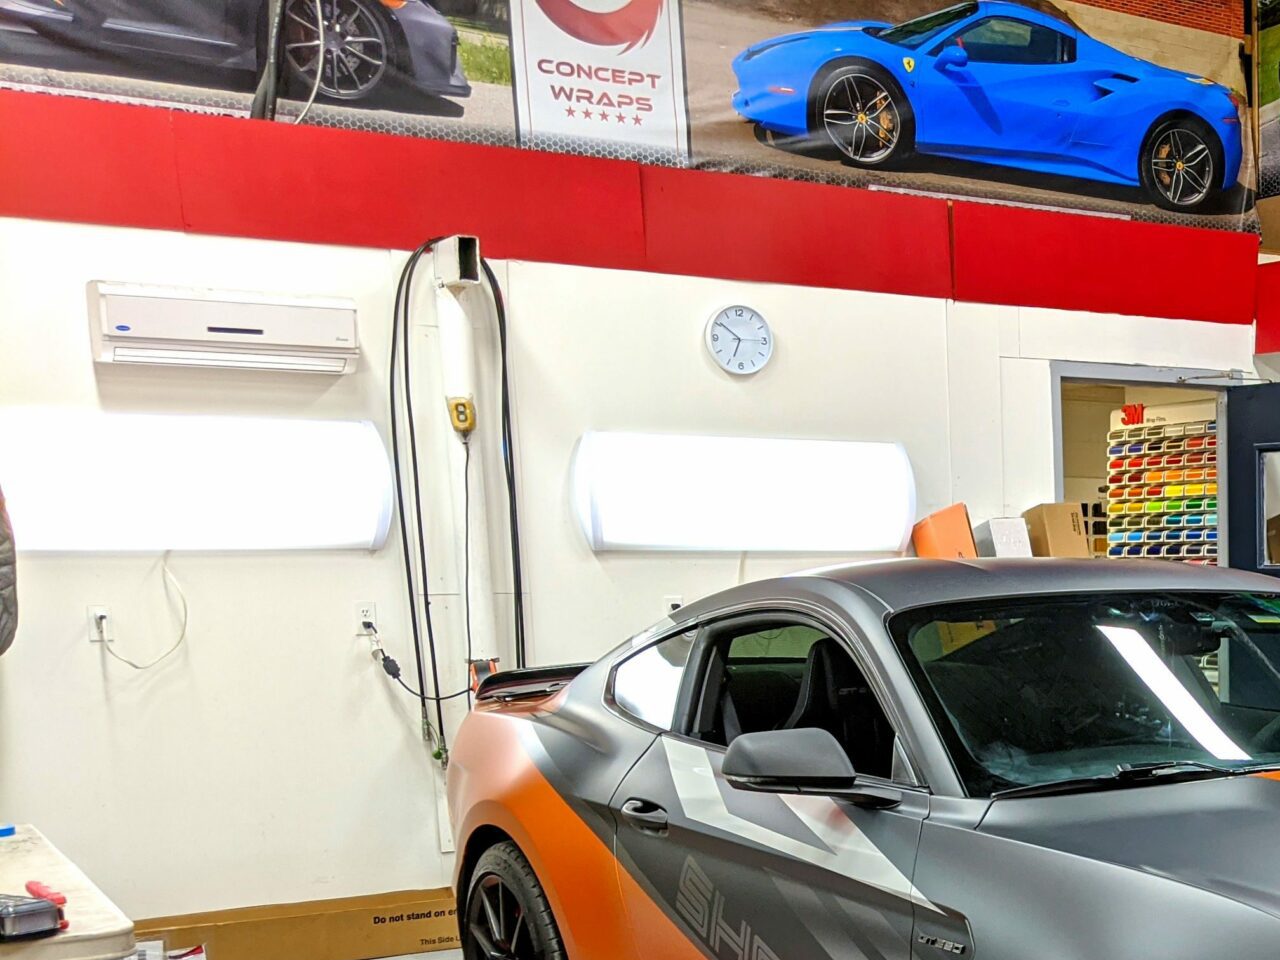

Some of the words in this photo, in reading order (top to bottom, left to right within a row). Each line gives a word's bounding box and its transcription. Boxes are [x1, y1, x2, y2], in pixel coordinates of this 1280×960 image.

[537, 59, 661, 89] CONCEPT
[550, 84, 653, 112] WRAPS
[734, 308, 744, 317] 12
[711, 333, 719, 342] 9
[761, 336, 768, 346] 3
[737, 361, 745, 370] 6
[1121, 404, 1144, 425] 3M
[373, 916, 387, 924] Do
[389, 914, 404, 923] not
[406, 911, 432, 920] stand
[420, 938, 437, 946] This
[438, 936, 454, 944] Side
